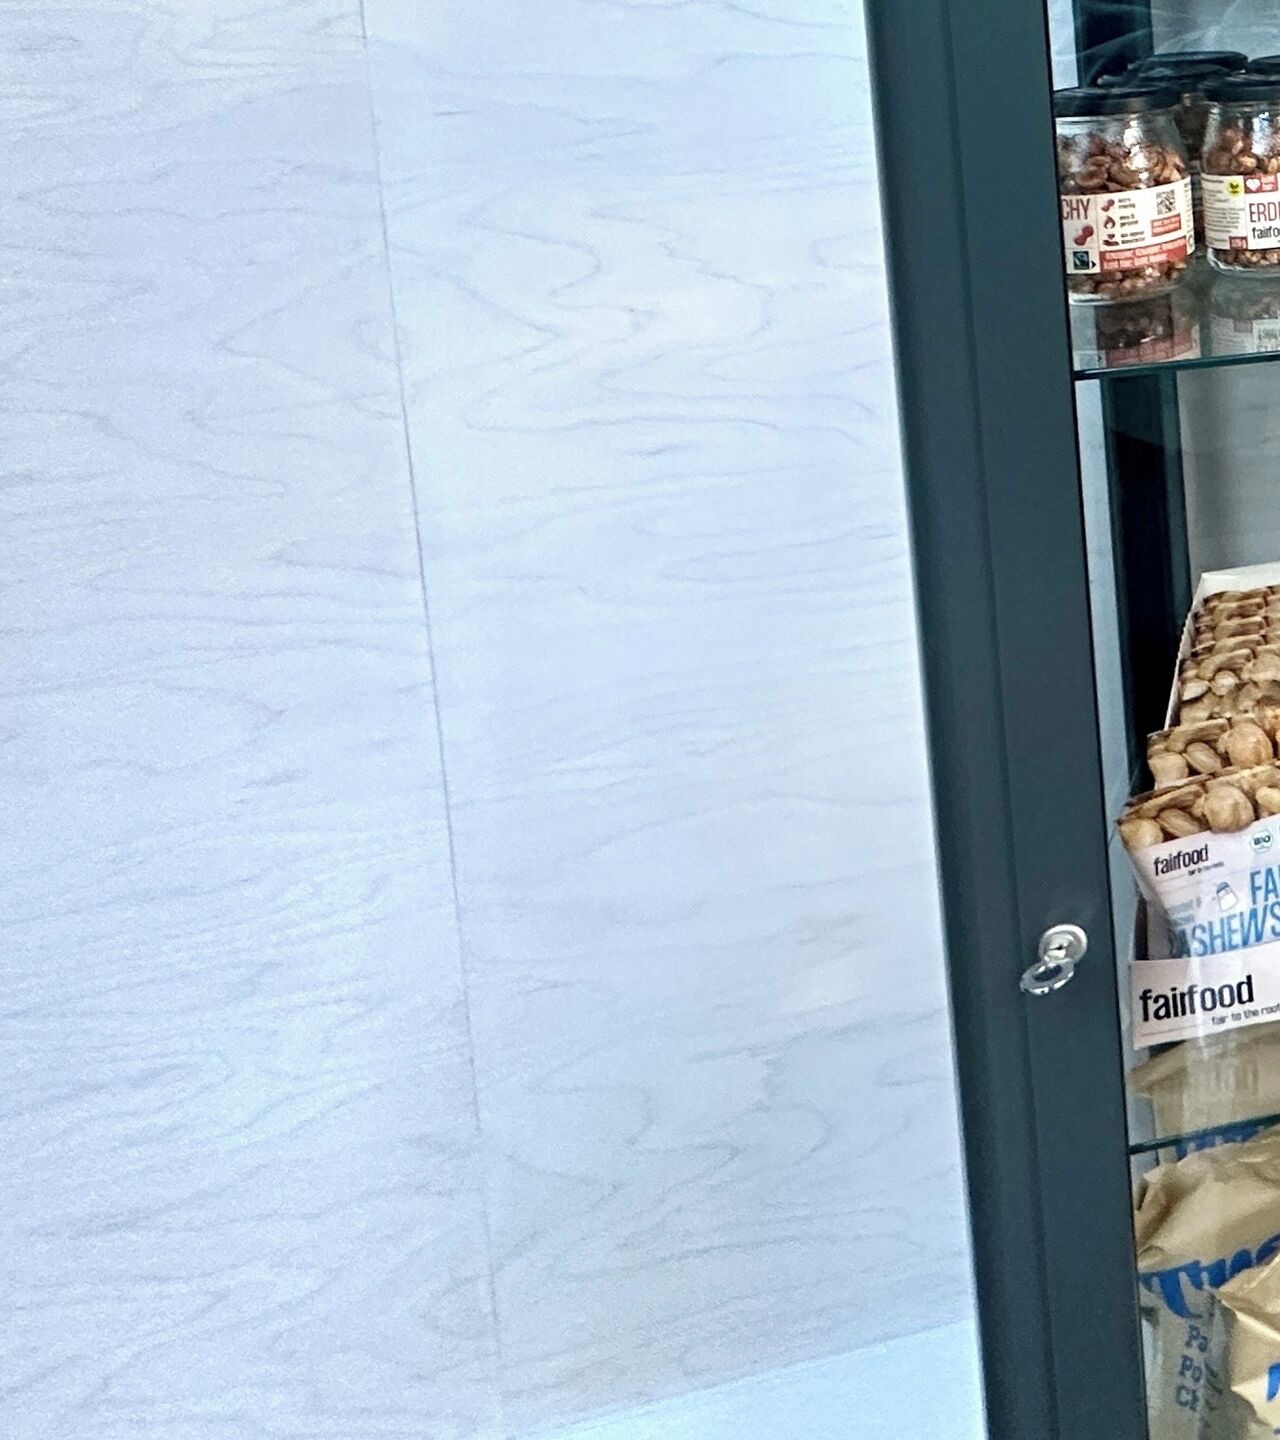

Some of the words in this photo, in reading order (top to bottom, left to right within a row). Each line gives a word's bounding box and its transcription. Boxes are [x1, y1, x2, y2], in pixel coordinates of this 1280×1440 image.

[1153, 844, 1209, 877] fairfood
[1139, 974, 1255, 1022] fairfood
[1211, 1014, 1228, 1026] fair
[1231, 1012, 1242, 1022] to
[1244, 1007, 1260, 1020] the
